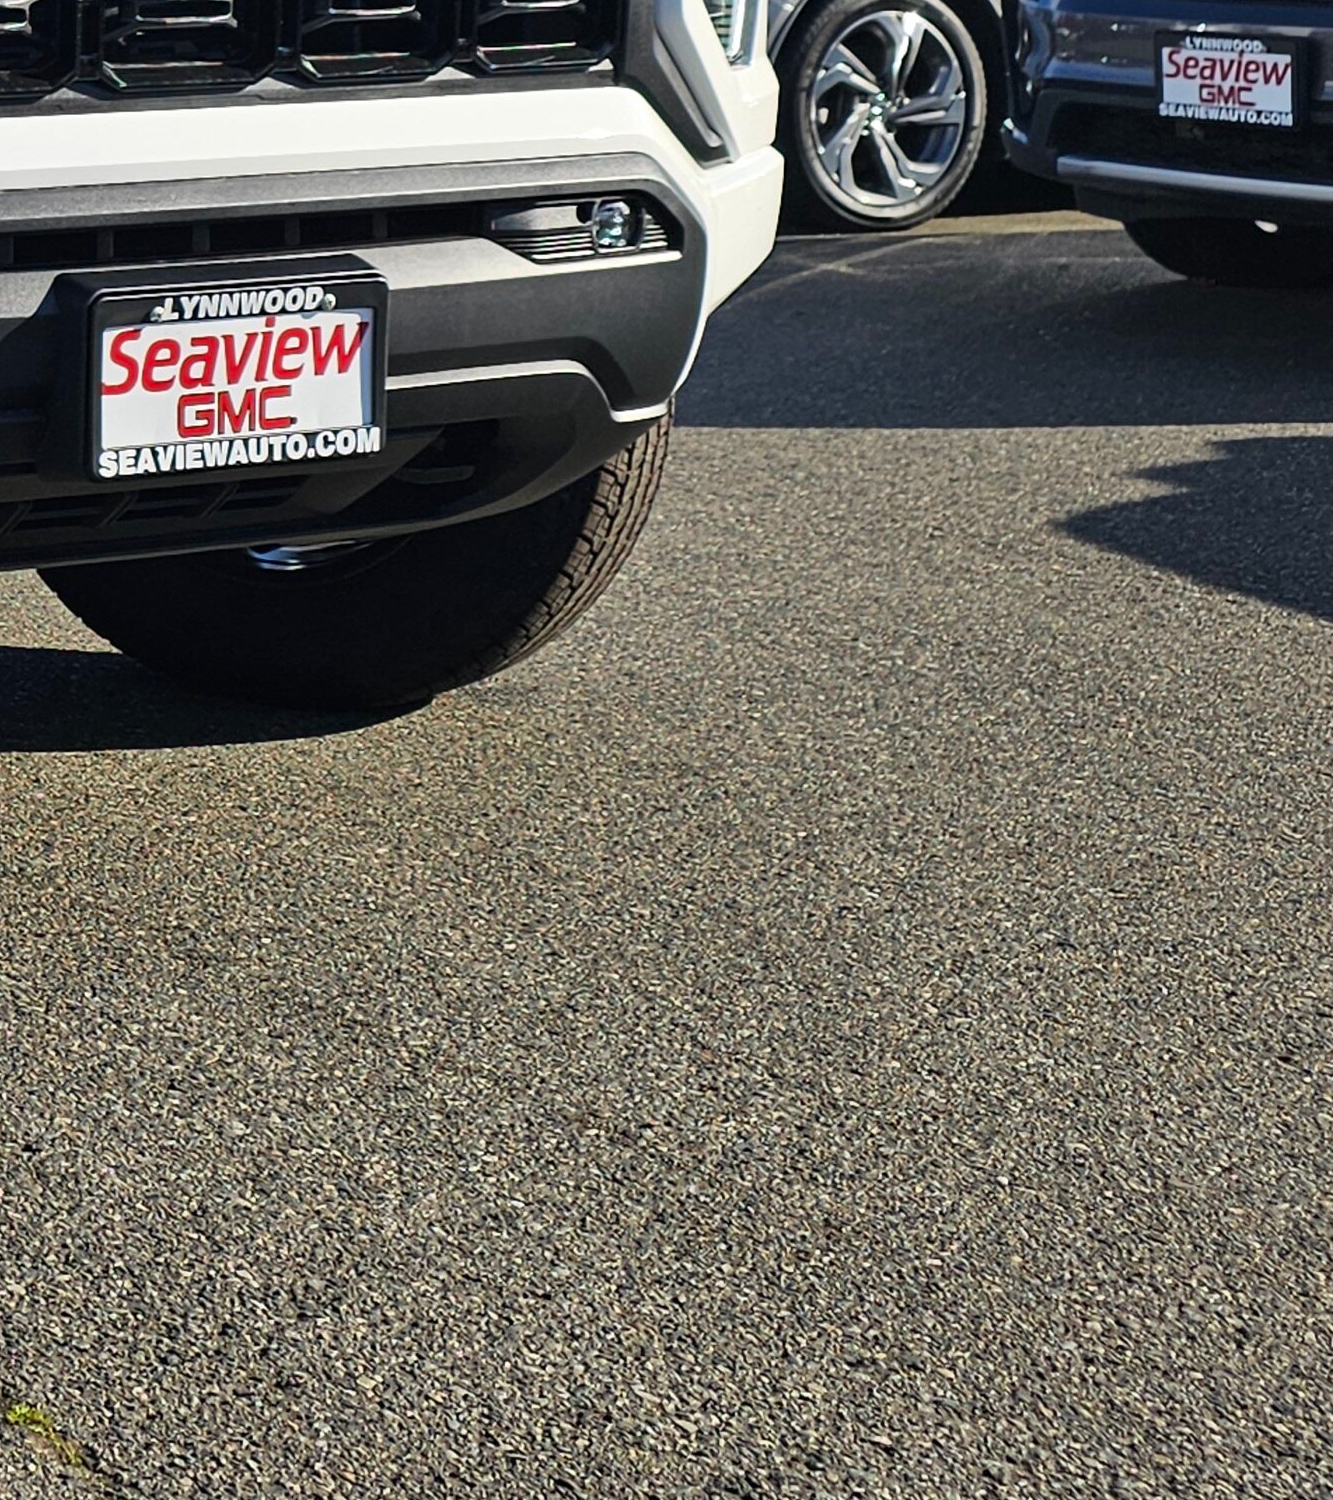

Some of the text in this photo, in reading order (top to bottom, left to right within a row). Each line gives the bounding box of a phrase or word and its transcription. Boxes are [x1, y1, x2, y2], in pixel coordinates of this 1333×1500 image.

[1184, 36, 1263, 53] LYNNWOOD
[1165, 50, 1292, 86] Seaview
[1199, 83, 1256, 107] GMC
[1159, 102, 1293, 127] SEAVIEWAUTO.COM
[162, 286, 325, 321] LYNNWOOD
[101, 315, 369, 396] Seaview
[177, 385, 297, 438] GMC
[98, 426, 381, 478] SEAVIEWAUTO.COM
